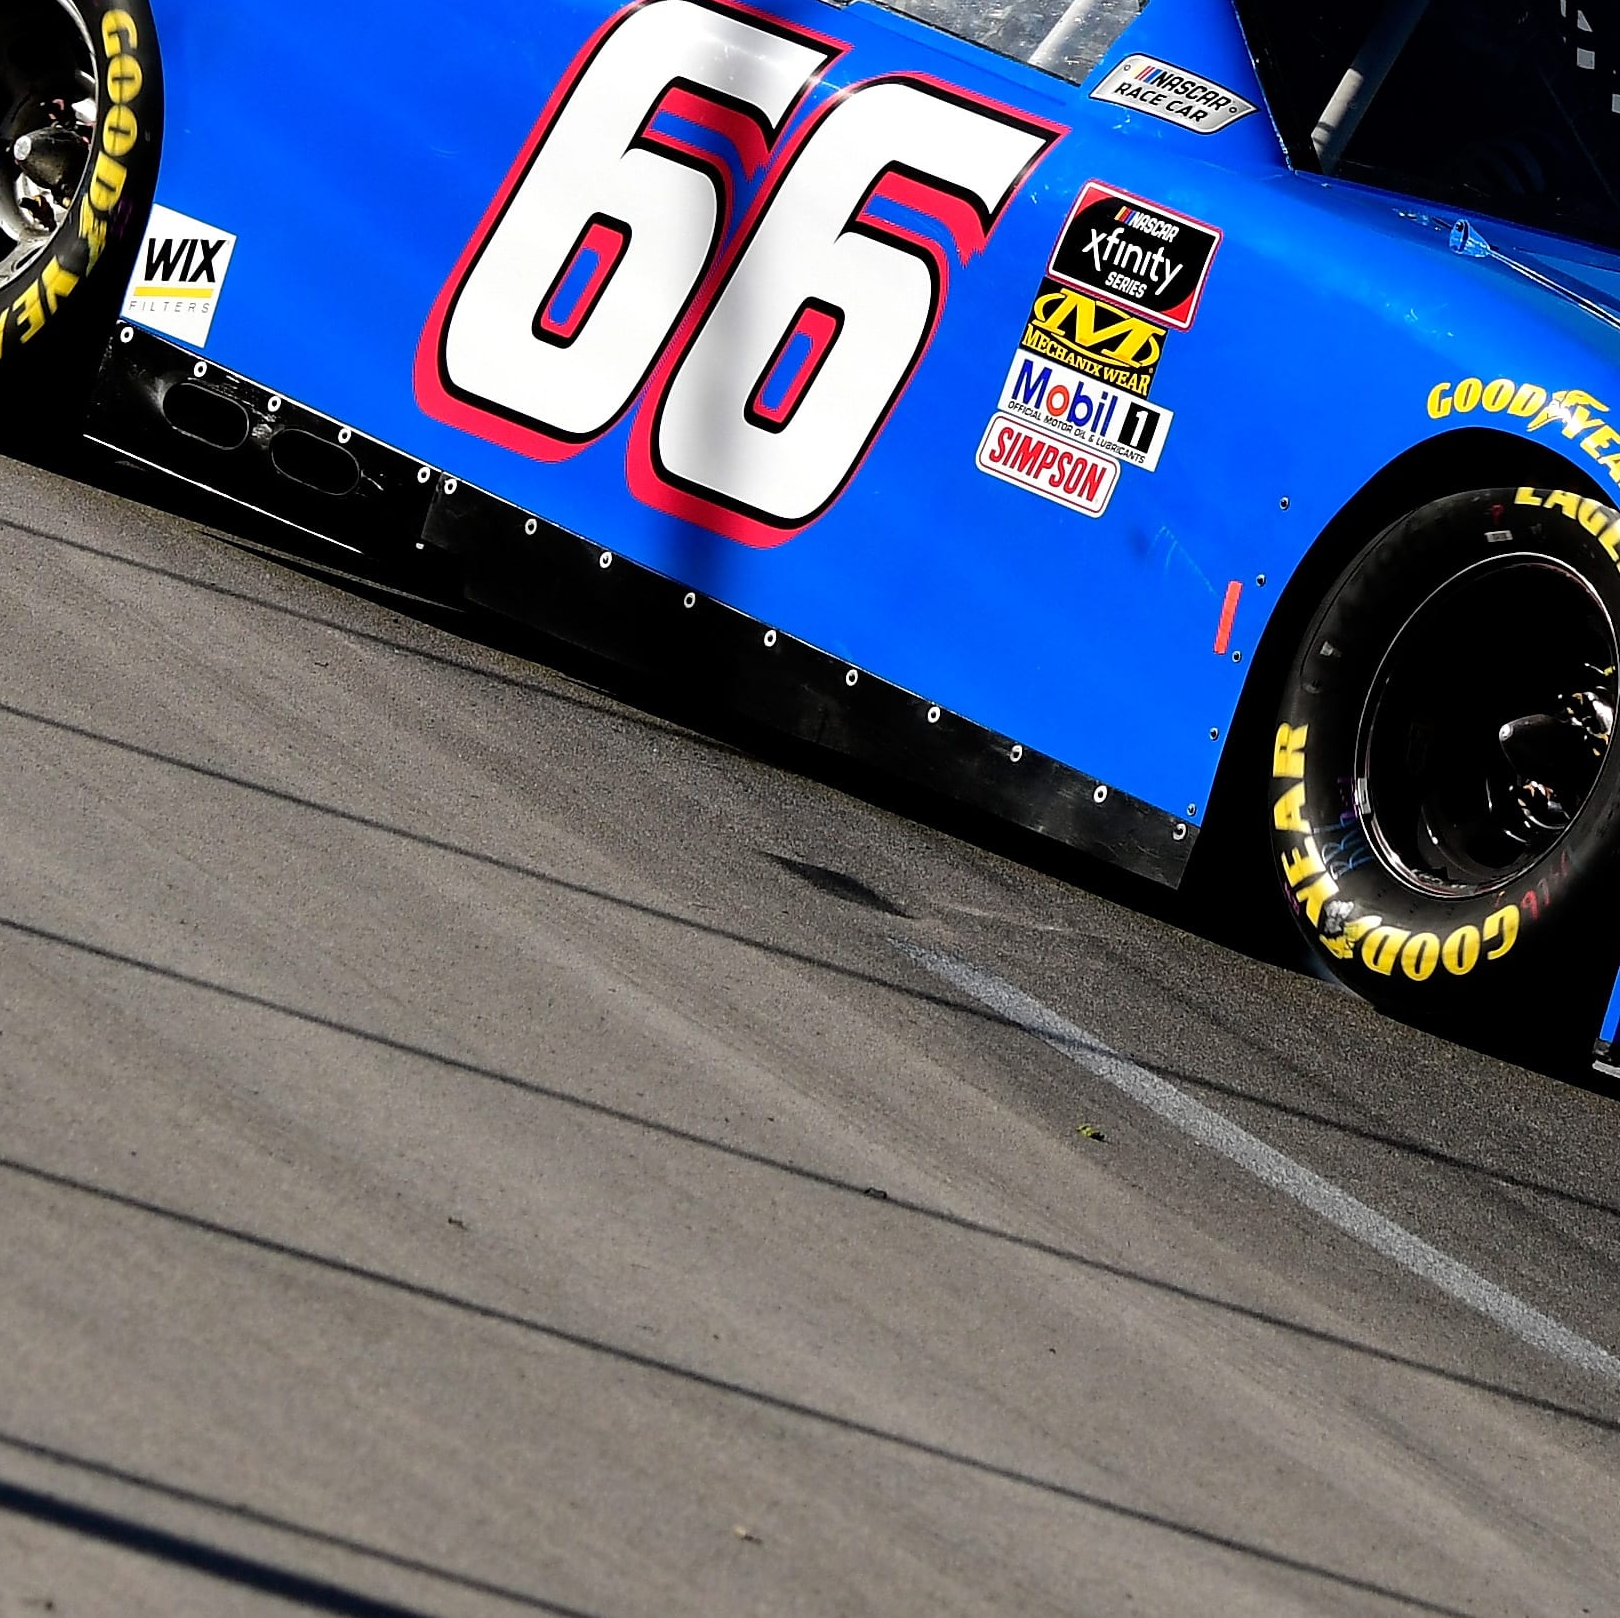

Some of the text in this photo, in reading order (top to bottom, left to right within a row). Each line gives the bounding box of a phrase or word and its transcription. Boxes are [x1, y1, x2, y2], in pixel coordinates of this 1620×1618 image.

[1114, 83, 1208, 122] RACE CAR
[1150, 71, 1232, 111] NASCAR
[1128, 211, 1180, 243] NASCAR
[144, 238, 227, 282] WIX
[1082, 227, 1184, 296] xfinity
[1105, 271, 1147, 298] SERIES
[129, 300, 210, 314] FILTERS
[1021, 323, 1151, 397] MECHANIX WEAR
[1011, 359, 1149, 448] Mobil 1
[1007, 400, 1146, 464] OFFICIAL MOTOR OIL & LUBRICANTS
[989, 426, 1107, 503] SIMPSON
[1272, 721, 1520, 982] GOODYEAR
